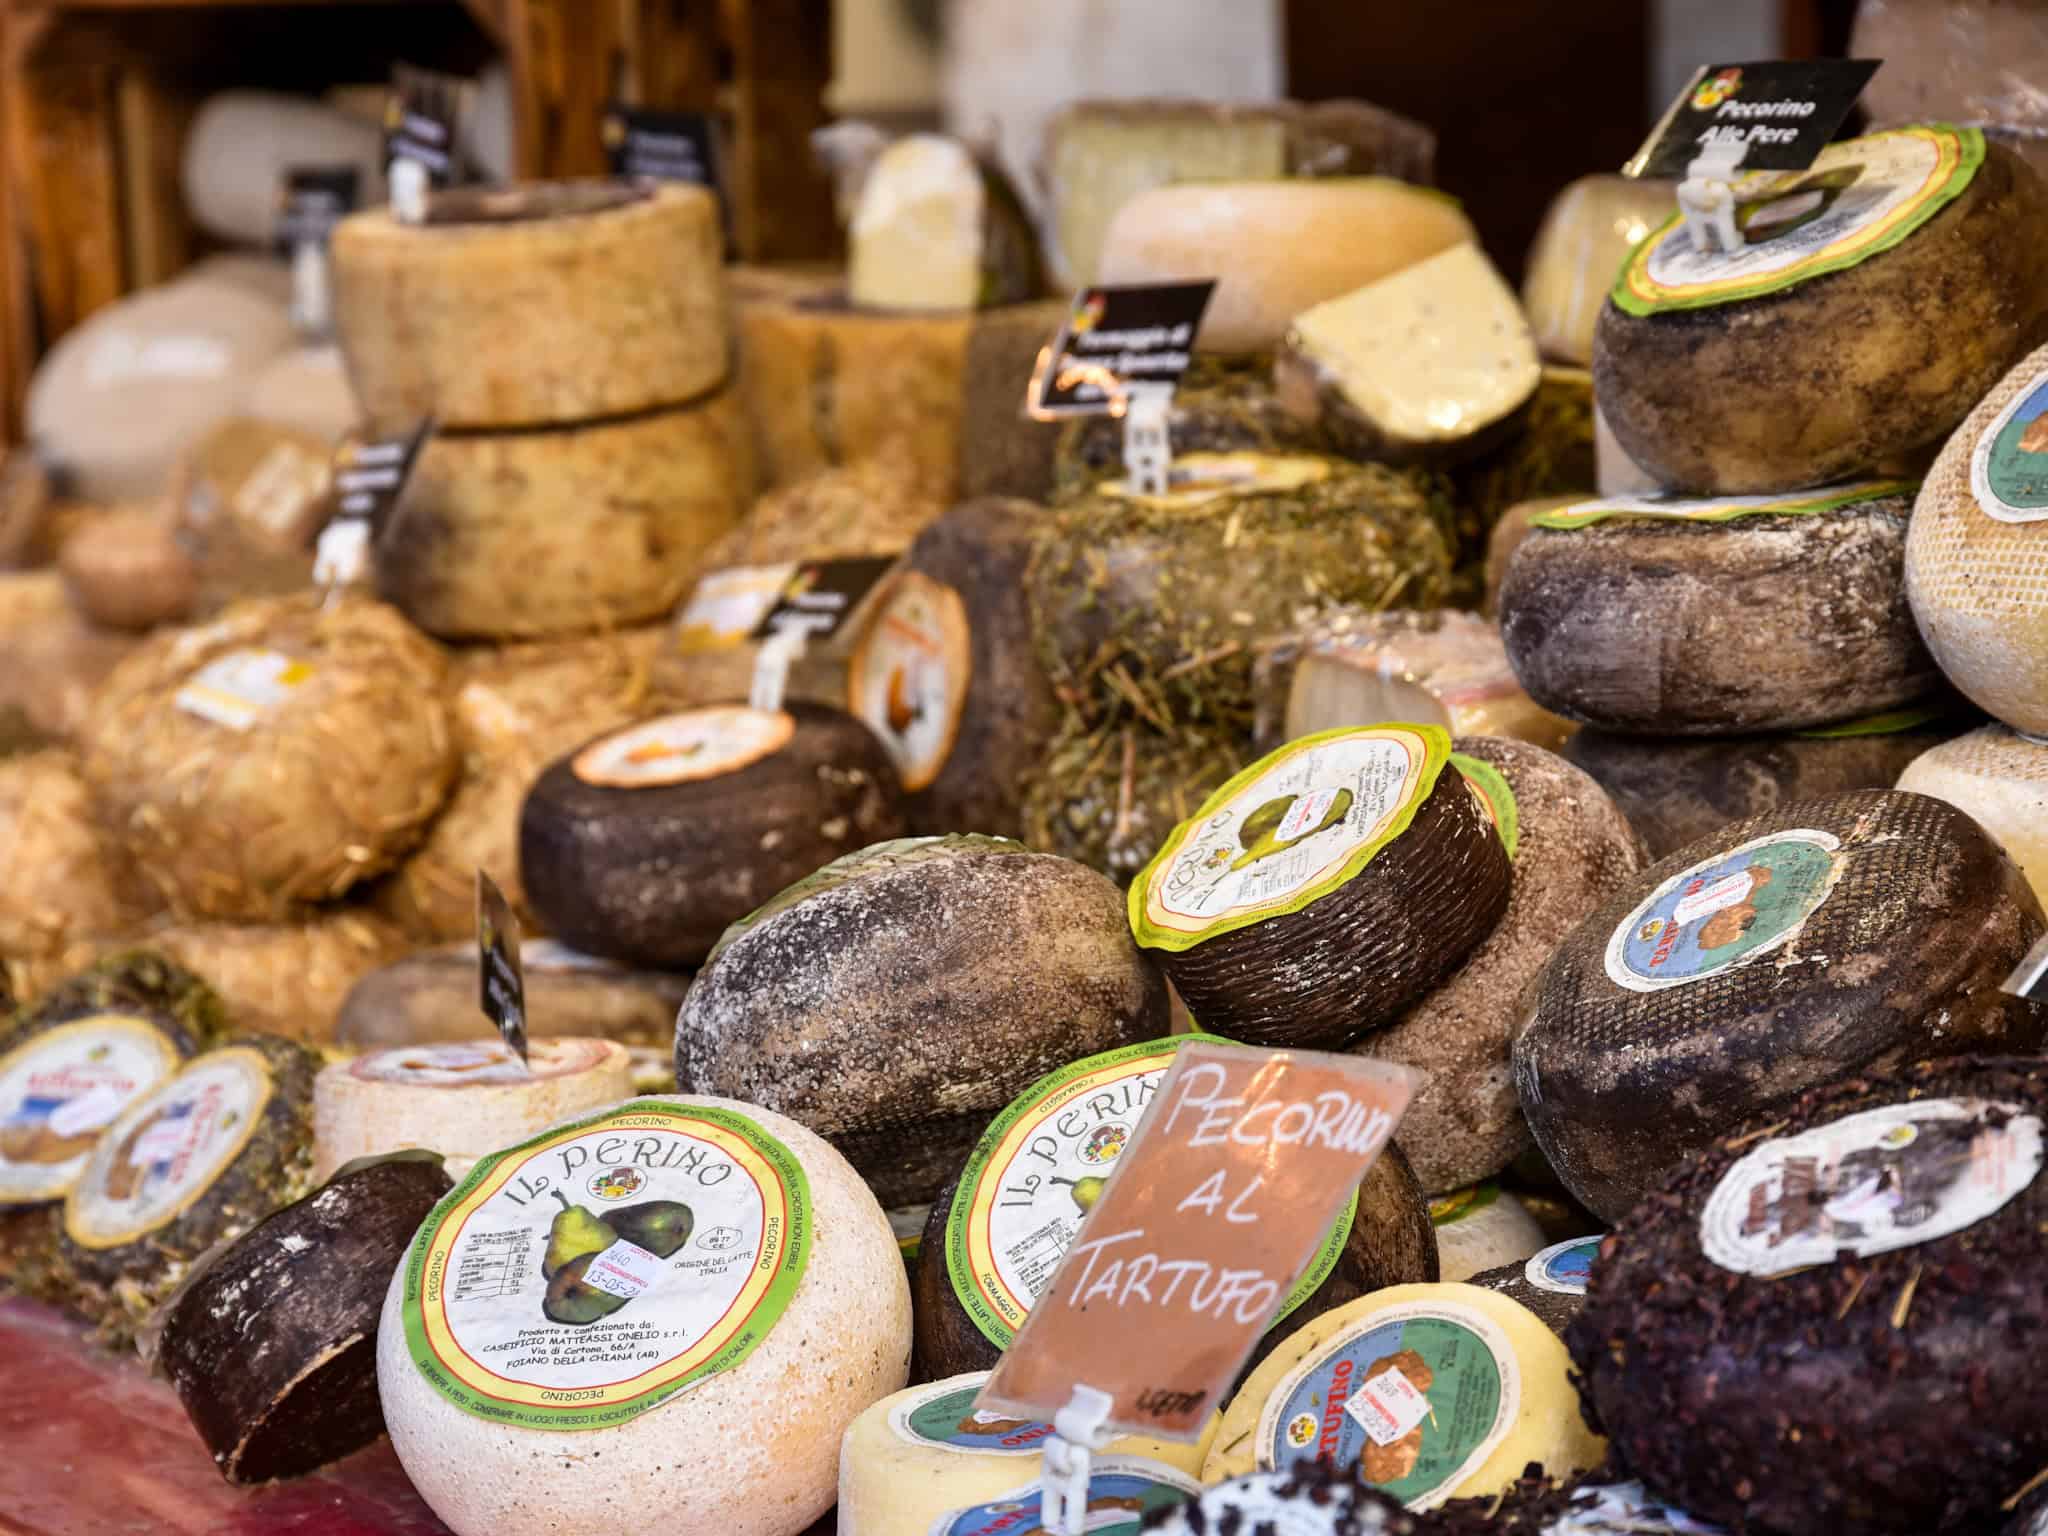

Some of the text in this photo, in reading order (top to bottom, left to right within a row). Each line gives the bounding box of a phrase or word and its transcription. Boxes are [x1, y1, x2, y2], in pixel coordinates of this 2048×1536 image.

[1716, 98, 1816, 117] Pecorino
[1746, 125, 1799, 144] Pere
[612, 1117, 672, 1127] PECORINO
[504, 1176, 550, 1206] IL
[557, 1137, 732, 1186] PERINO
[1001, 1175, 1041, 1207] IL
[1176, 1168, 1264, 1223] AL
[760, 1216, 779, 1270] PECORINO
[712, 1256, 727, 1266] DEL
[428, 1250, 445, 1302] PECORINO
[698, 1266, 728, 1277] ITALIA
[1070, 1229, 1281, 1324] TARTUFO
[982, 1272, 1018, 1321] FORMAGGIO
[518, 1327, 561, 1338] Prodotto
[574, 1322, 633, 1335] confezionato
[482, 1336, 545, 1352] CASEIFICIO
[549, 1333, 613, 1346] MATTEASSI
[617, 1330, 660, 1342] ONELIO
[531, 1346, 548, 1355] Via
[610, 1342, 636, 1352] 66/A
[506, 1357, 549, 1369] FOIANO
[553, 1355, 585, 1366] DELLA
[589, 1352, 632, 1364] CHIANA
[541, 1390, 604, 1402] PECORINO
